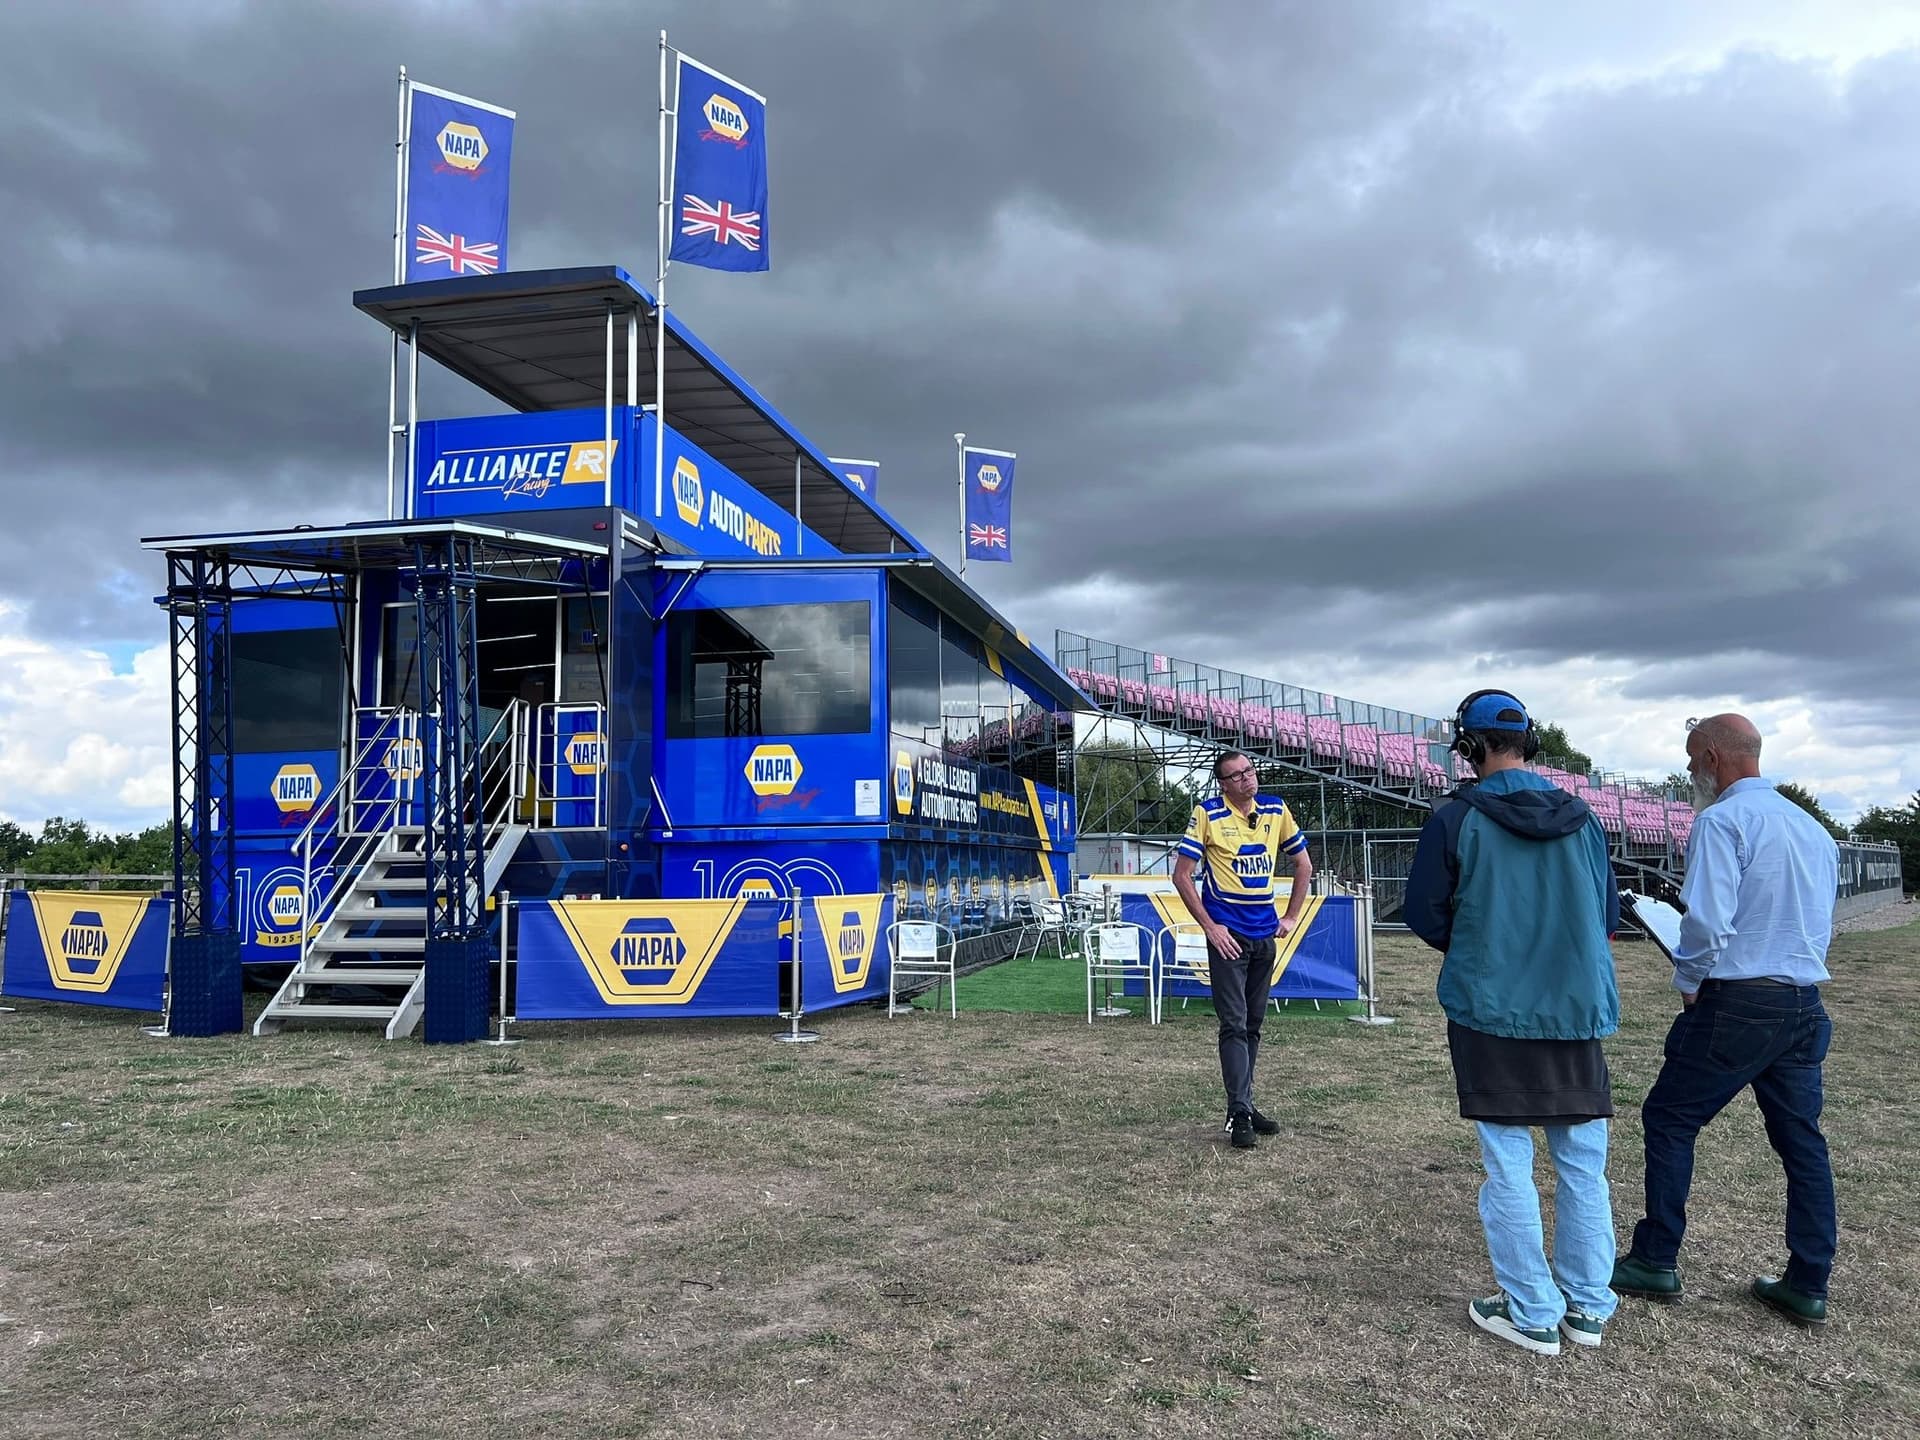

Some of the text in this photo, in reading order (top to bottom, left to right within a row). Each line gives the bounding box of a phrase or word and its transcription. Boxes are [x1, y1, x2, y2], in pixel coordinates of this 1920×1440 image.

[712, 104, 742, 131] NAPA
[445, 132, 480, 158] NAPA
[427, 451, 566, 486] ALLIANCE
[501, 471, 556, 501] Racing
[678, 471, 781, 556] NAPA AUTO PARTS
[754, 759, 793, 781] NAPA
[917, 756, 923, 783] A
[923, 758, 949, 789] GLOBAL
[949, 765, 970, 795] LEADER
[280, 777, 312, 799] NAPA
[921, 791, 978, 825] AUTOMOTIVE PARTS
[1240, 856, 1269, 875] NAPA
[274, 897, 300, 914] NAPA
[69, 928, 100, 957] NAPA
[624, 937, 674, 966] NAPA
[843, 928, 861, 957] NAPA
